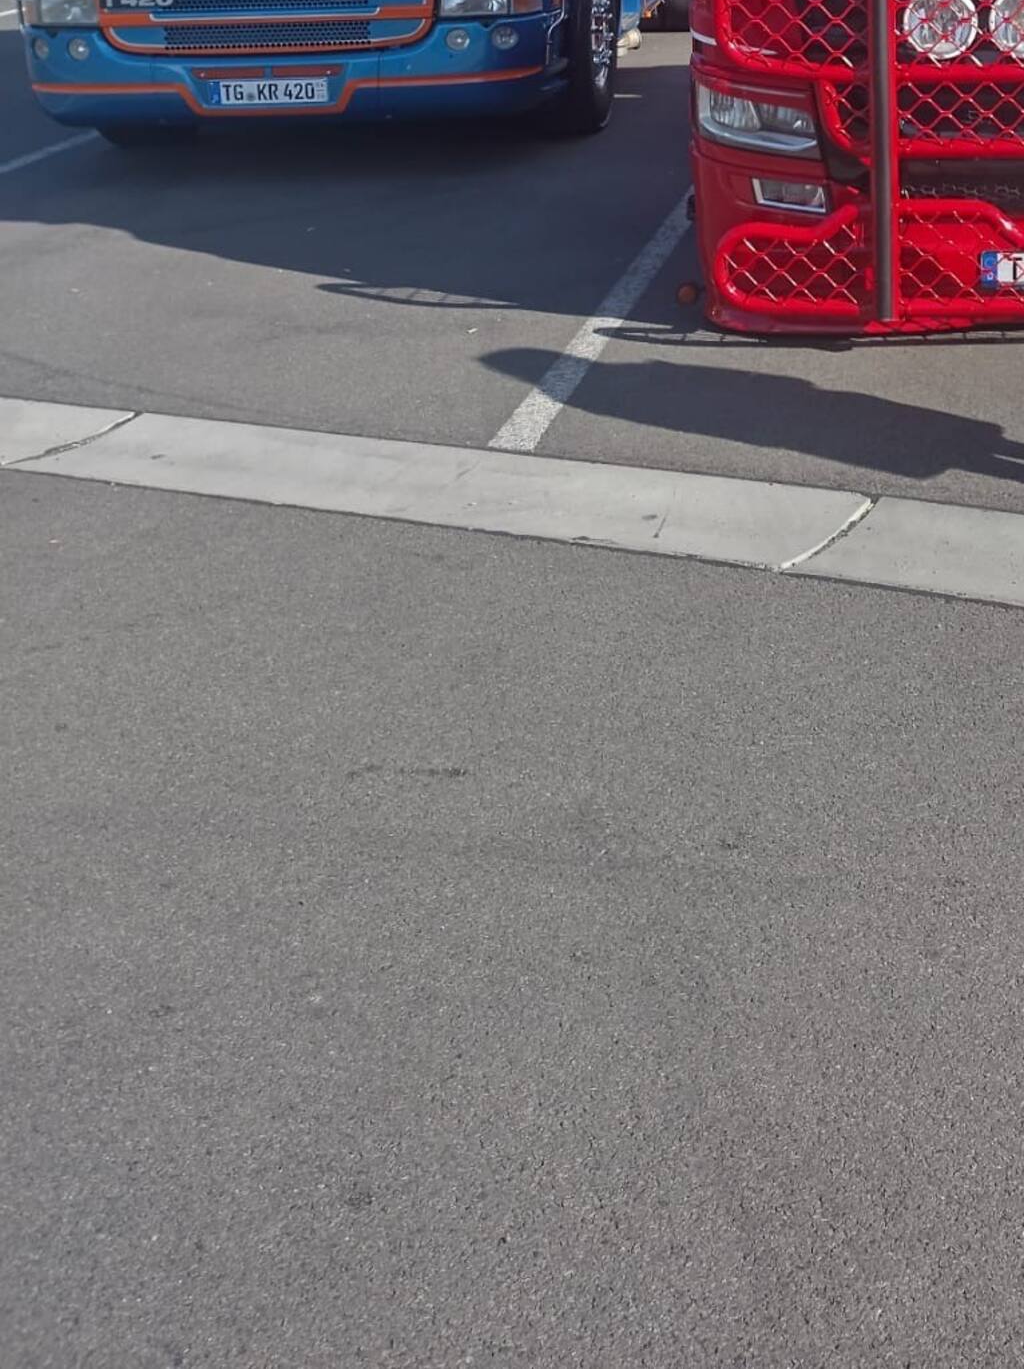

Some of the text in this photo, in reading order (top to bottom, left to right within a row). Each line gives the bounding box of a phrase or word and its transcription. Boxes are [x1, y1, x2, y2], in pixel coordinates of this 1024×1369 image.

[222, 82, 315, 101] TG KR 420
